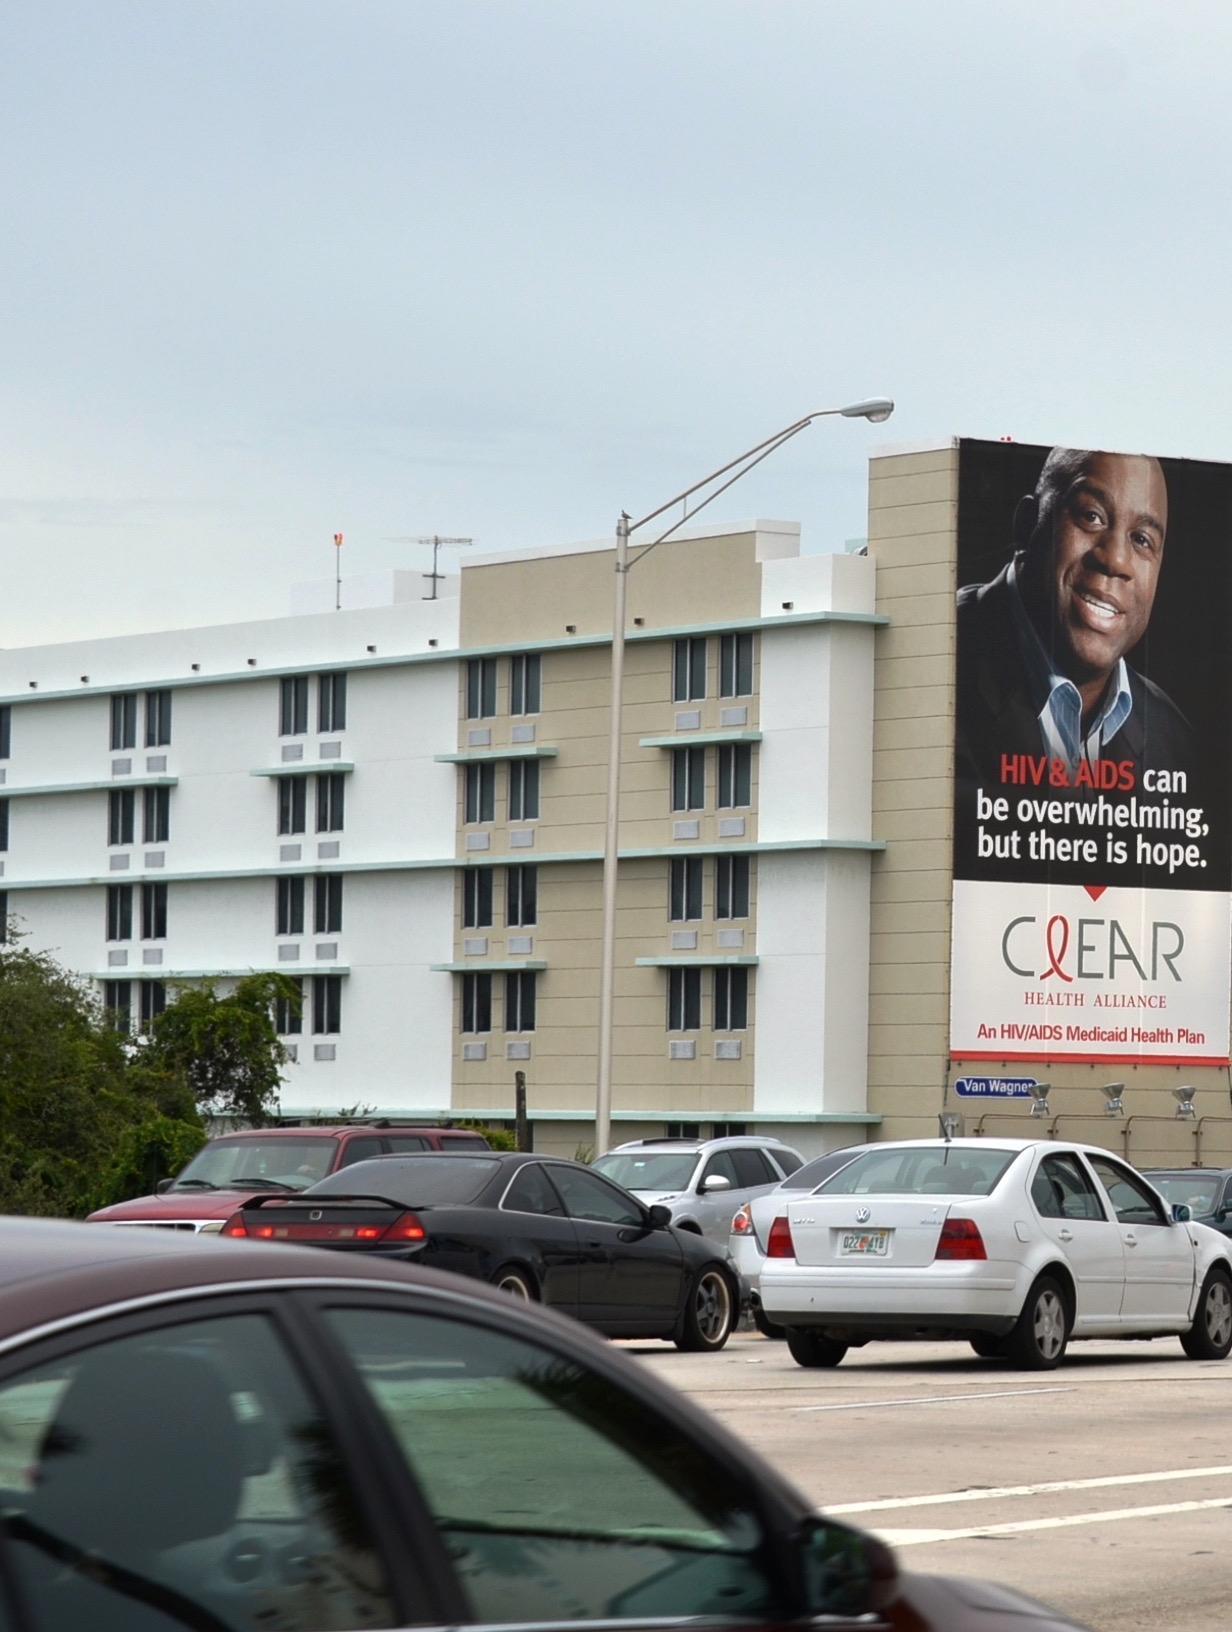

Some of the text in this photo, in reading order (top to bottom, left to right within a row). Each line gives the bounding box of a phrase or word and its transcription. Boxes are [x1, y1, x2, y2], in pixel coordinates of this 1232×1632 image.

[1000, 753, 1188, 794] HIV & AIDS can
[976, 788, 1210, 838] be overwhelming,
[977, 826, 1207, 874] but there is hope.
[1023, 991, 1167, 1009] HEALTH ALLIANCE
[977, 1023, 1206, 1045] An HIV/AIDS Medicaid Health Plan
[963, 1079, 986, 1092] Van
